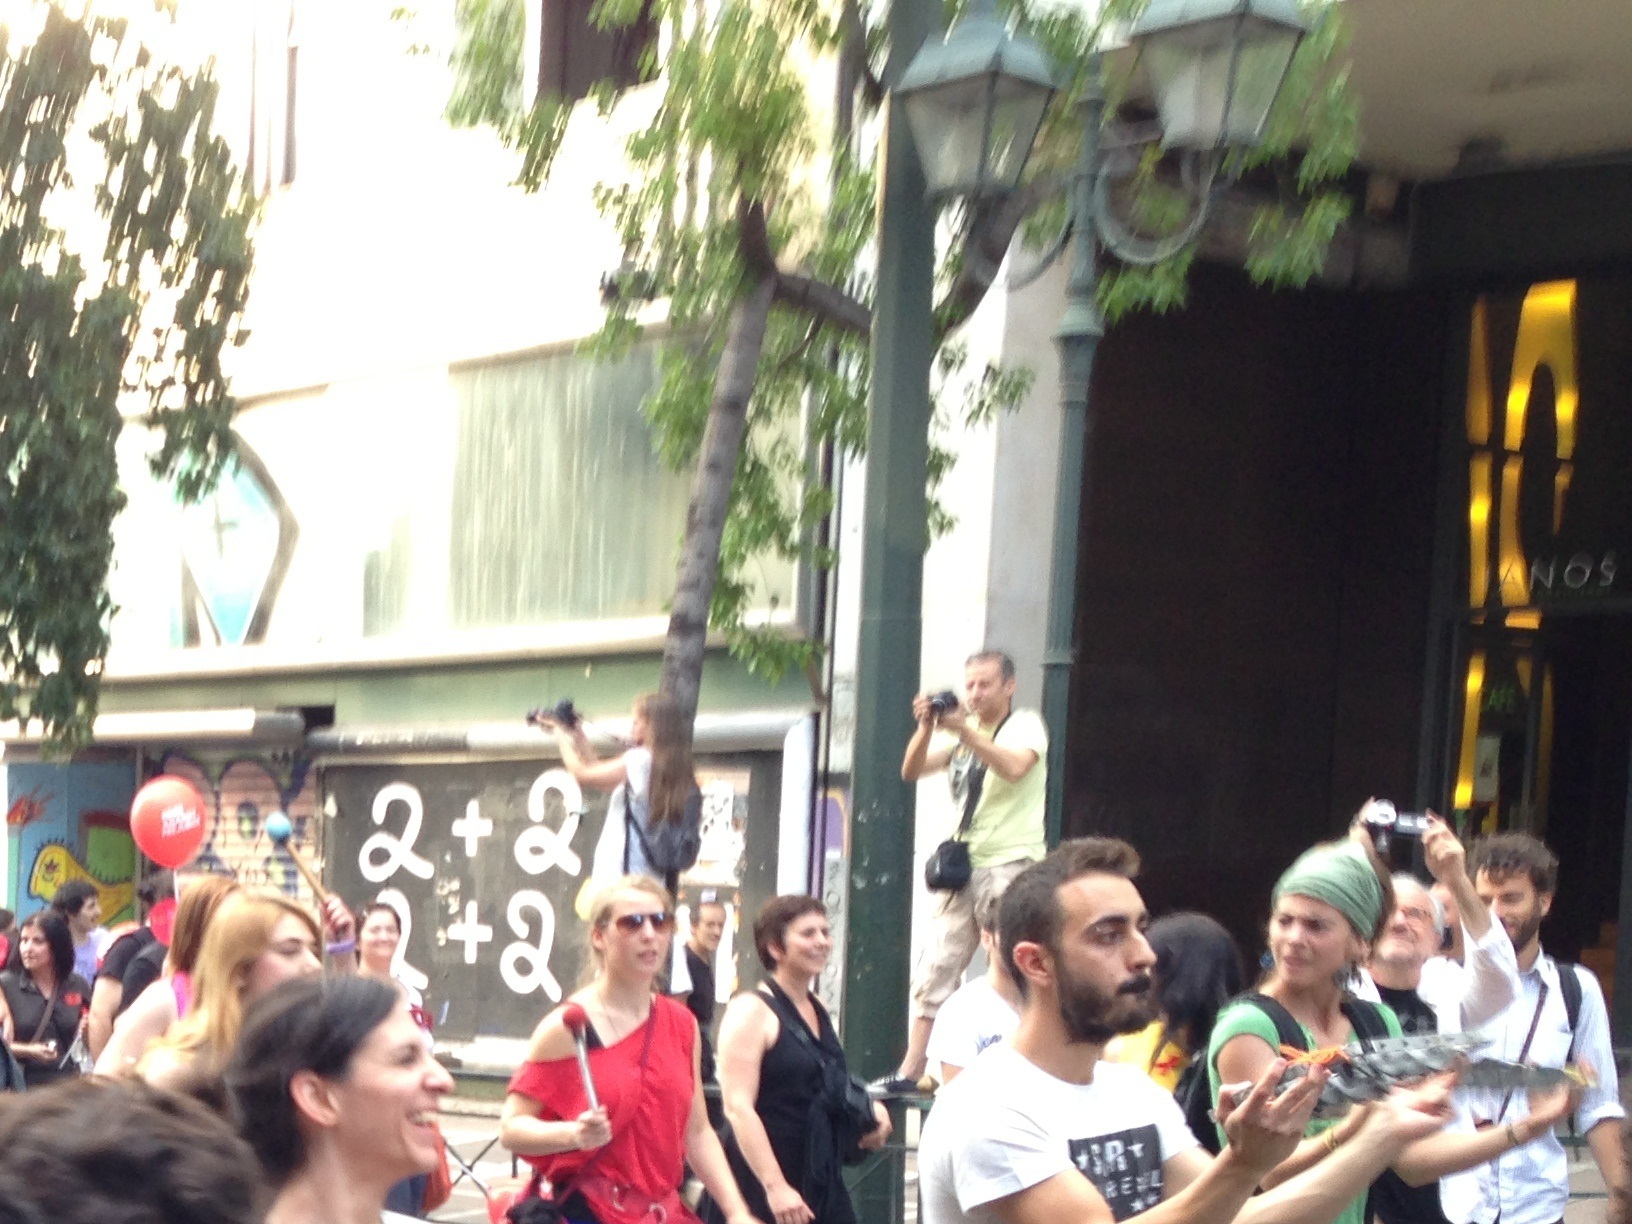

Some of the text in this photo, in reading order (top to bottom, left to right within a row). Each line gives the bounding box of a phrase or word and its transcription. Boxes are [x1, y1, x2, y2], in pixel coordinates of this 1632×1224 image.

[359, 782, 435, 882] 2
[514, 768, 582, 876] 2
[500, 889, 562, 1003] 2
